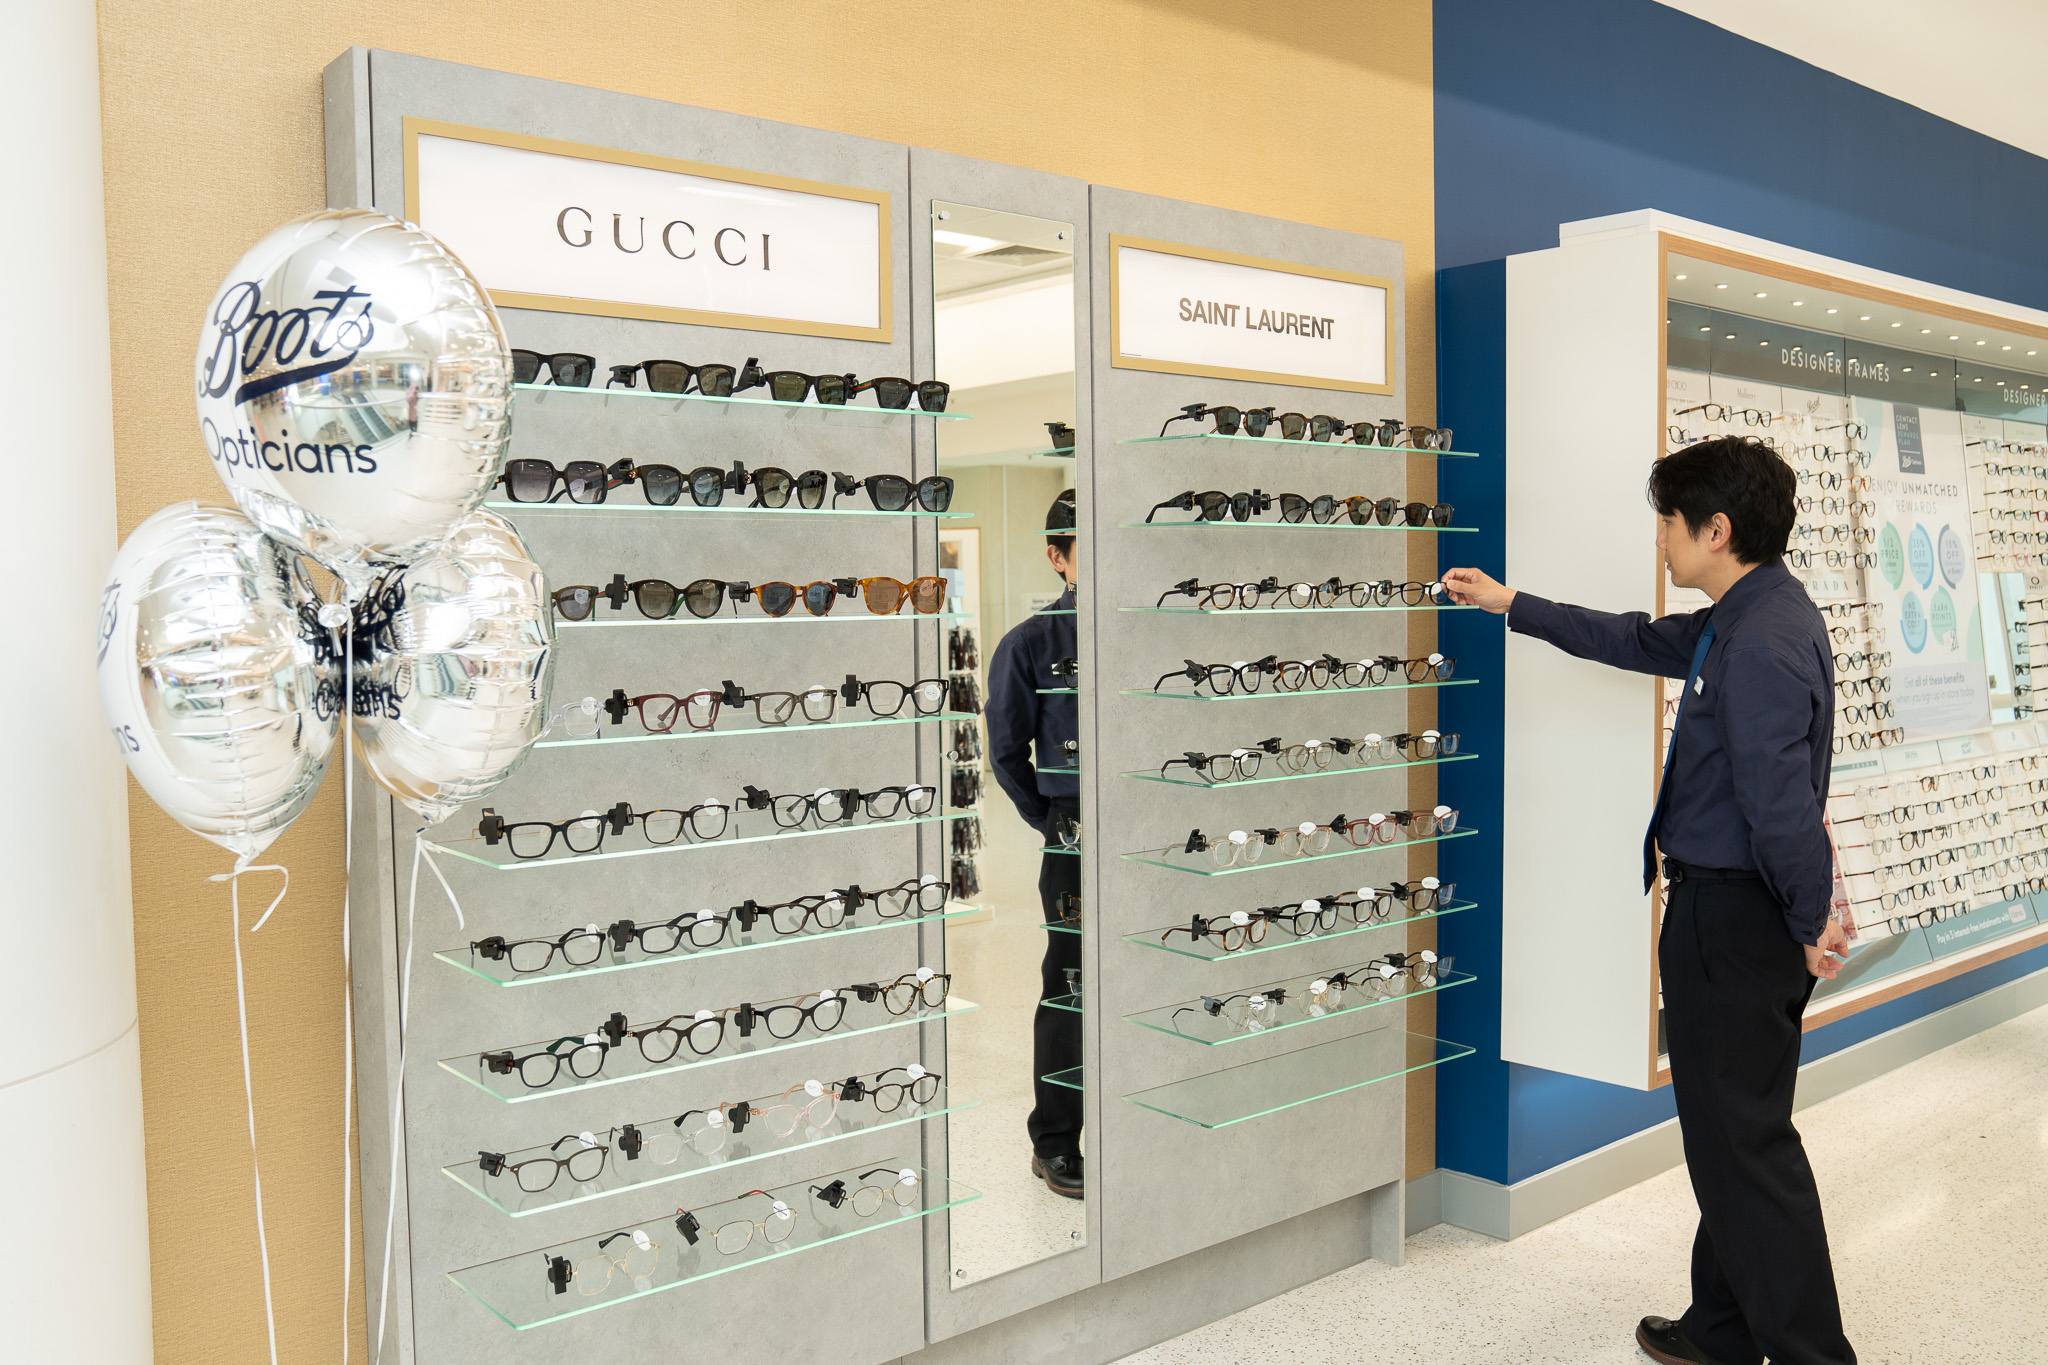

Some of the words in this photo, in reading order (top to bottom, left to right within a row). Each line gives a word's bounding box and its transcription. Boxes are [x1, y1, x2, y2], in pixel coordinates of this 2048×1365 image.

[557, 206, 771, 271] GUCCI
[1179, 297, 1240, 327] SAINT
[1246, 306, 1335, 340] LAURENT
[199, 279, 374, 407] Boots
[1781, 348, 1842, 375] DESIGNER
[1848, 361, 1890, 383] FRAMES
[2003, 388, 2046, 408] DESIGNER
[1896, 415, 1918, 424] CONTACT
[1896, 423, 1909, 431] LENS
[203, 417, 377, 478] Opticians
[1872, 478, 1898, 495] ENJOY
[1902, 482, 1958, 497] UNMATCHED
[1896, 500, 1937, 515] REWARDS
[1881, 549, 1899, 560] PRICE
[1914, 550, 1926, 560] OFF
[1947, 550, 1958, 560] OFF
[1944, 672, 1965, 684] benefits
[1936, 934, 1946, 944] Pay
